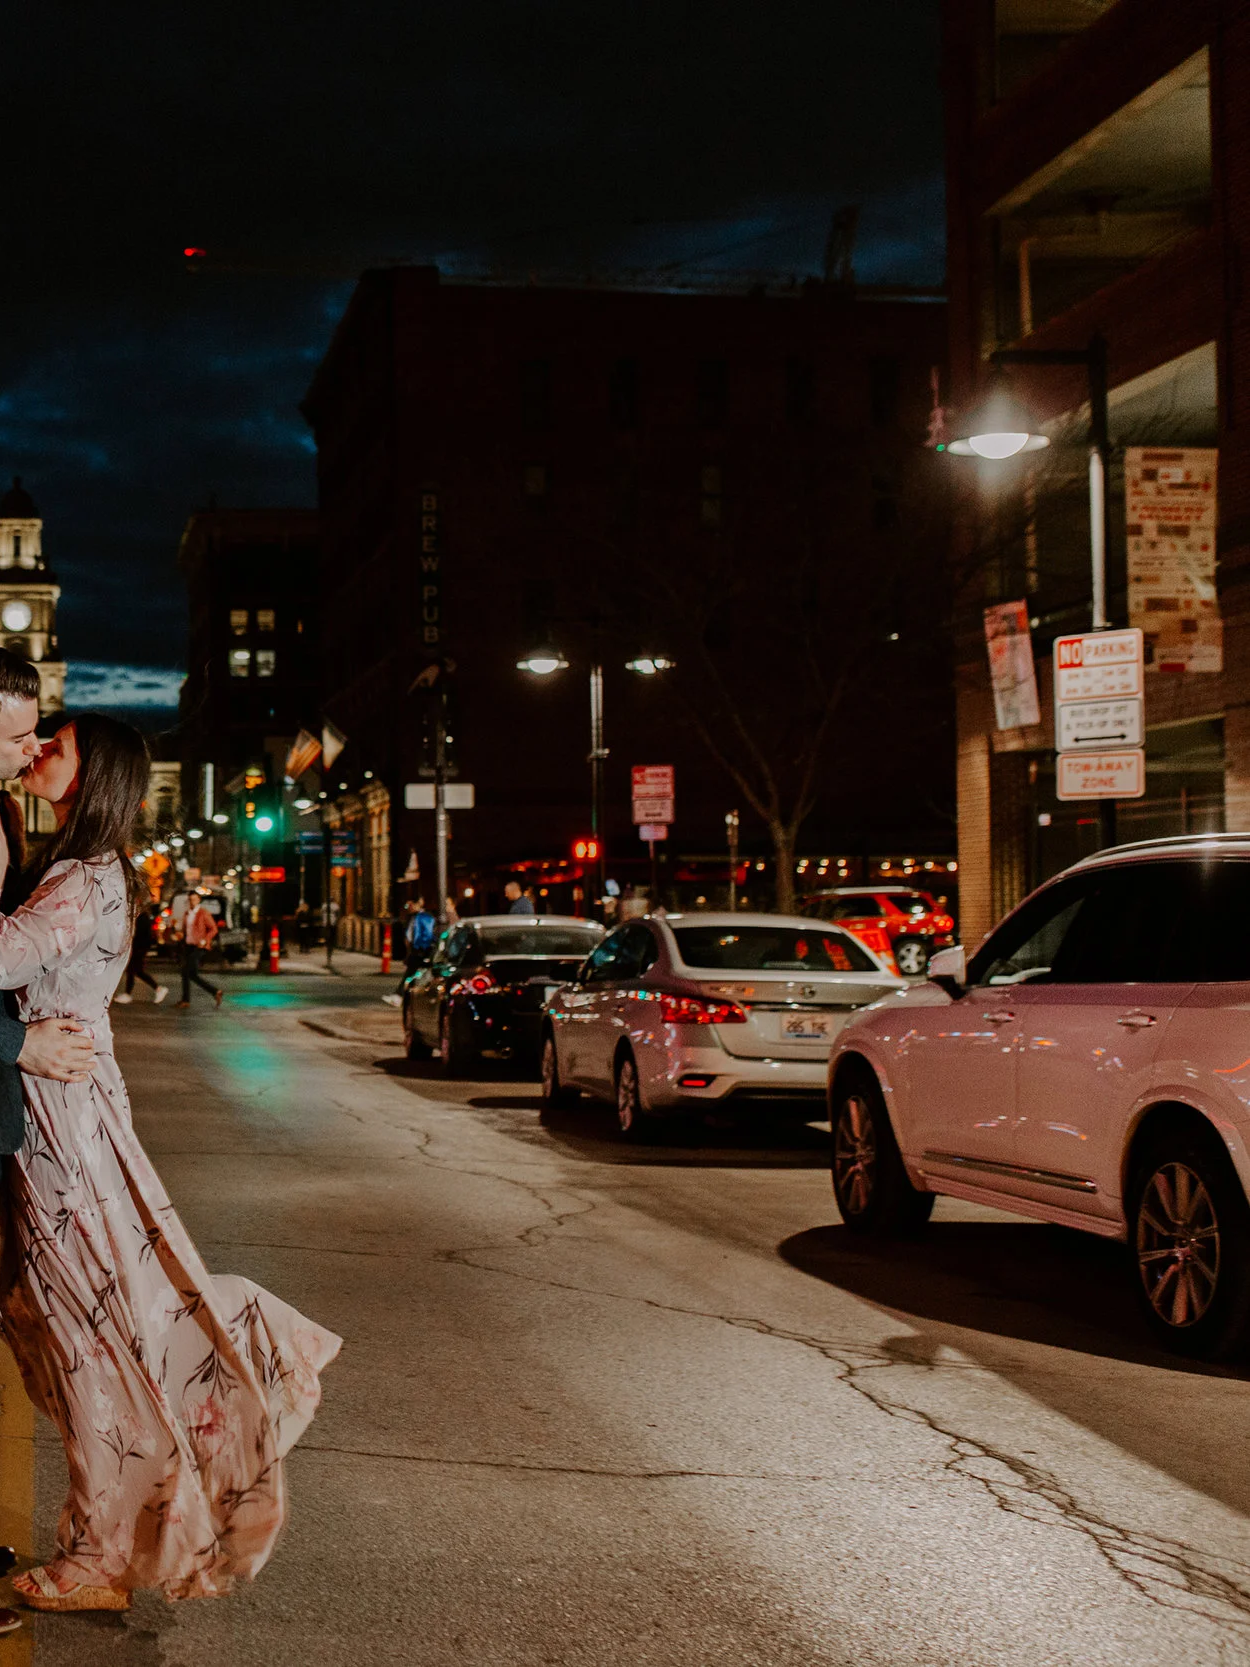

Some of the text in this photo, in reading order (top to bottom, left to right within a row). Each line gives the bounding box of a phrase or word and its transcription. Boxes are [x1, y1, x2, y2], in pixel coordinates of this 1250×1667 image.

[420, 494, 440, 643] BREW PUB
[1060, 640, 1134, 665] NO PARKING
[1080, 776, 1117, 789] ZONE
